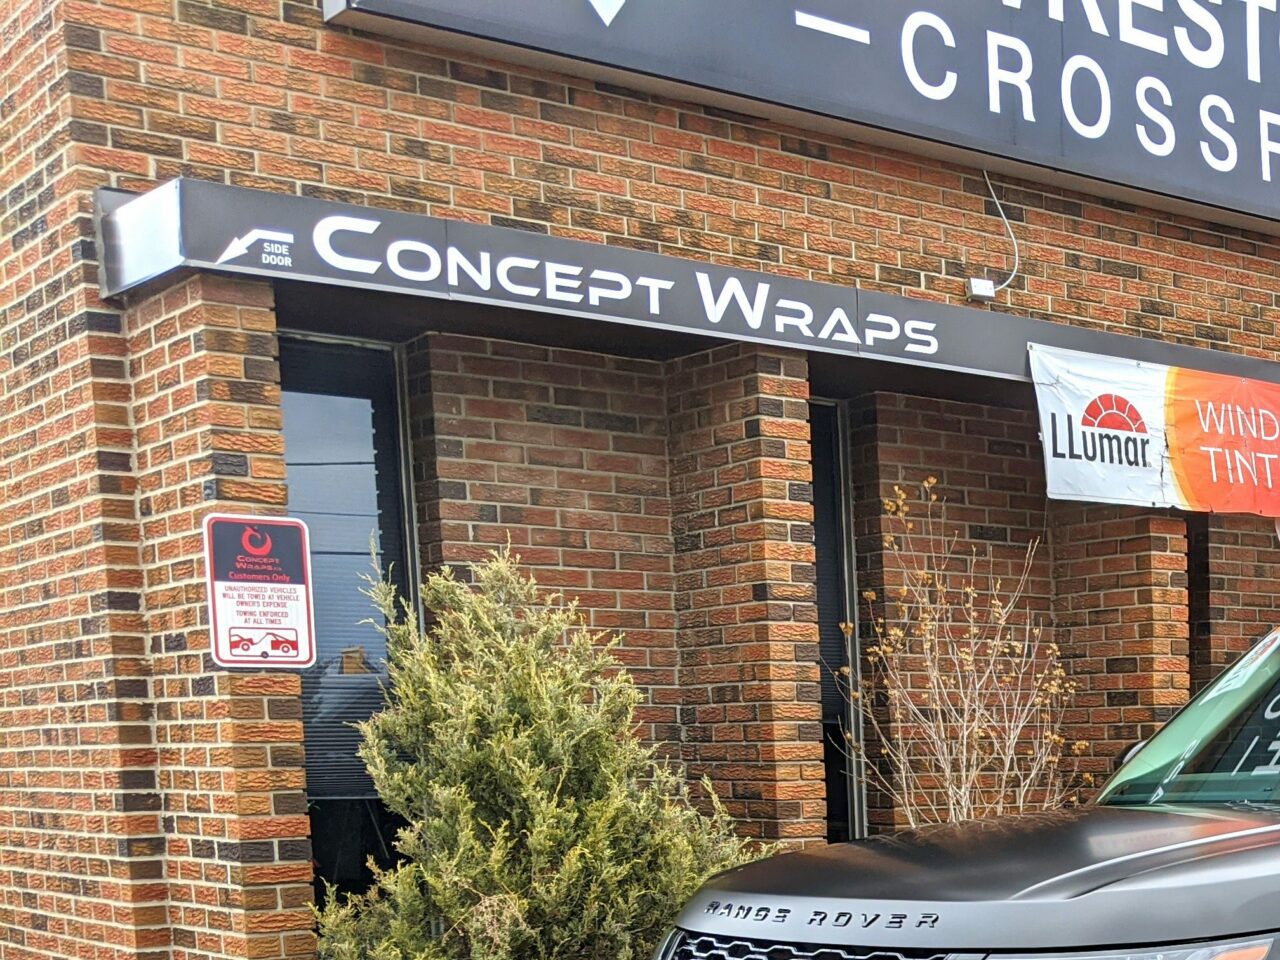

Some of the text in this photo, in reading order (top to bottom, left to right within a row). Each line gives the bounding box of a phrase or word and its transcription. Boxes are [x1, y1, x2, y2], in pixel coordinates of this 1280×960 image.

[263, 242, 290, 255] SIDE
[261, 253, 293, 267] DOOR
[312, 215, 939, 355] CONCEPT WRAPS
[1051, 412, 1150, 468] LLumar
[228, 571, 290, 582] Customers Only
[224, 585, 297, 594] UNAUTHORIZED VEHICLES
[247, 593, 266, 601] TOWED
[277, 594, 300, 602] VEHICLE
[244, 617, 251, 625] AT
[704, 900, 940, 929] RANGE ROVER
